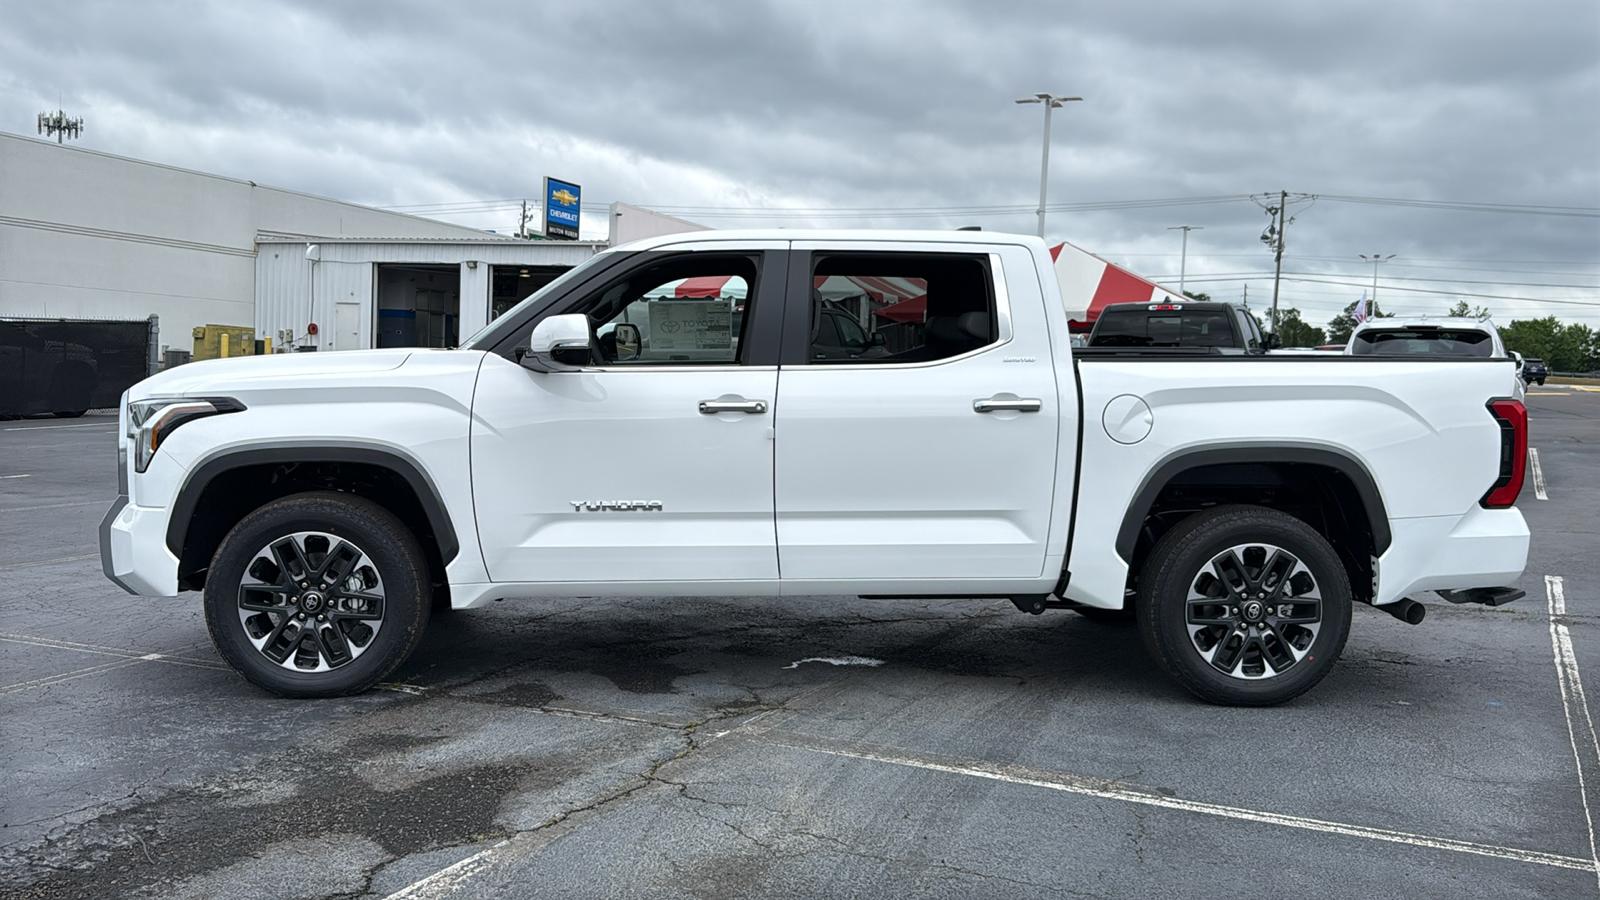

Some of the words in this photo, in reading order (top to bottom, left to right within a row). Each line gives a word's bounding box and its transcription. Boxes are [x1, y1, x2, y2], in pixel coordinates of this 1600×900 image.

[550, 209, 578, 221] CHEVROLET
[682, 320, 720, 328] TOYOTA
[569, 500, 663, 512] TUNDRA
